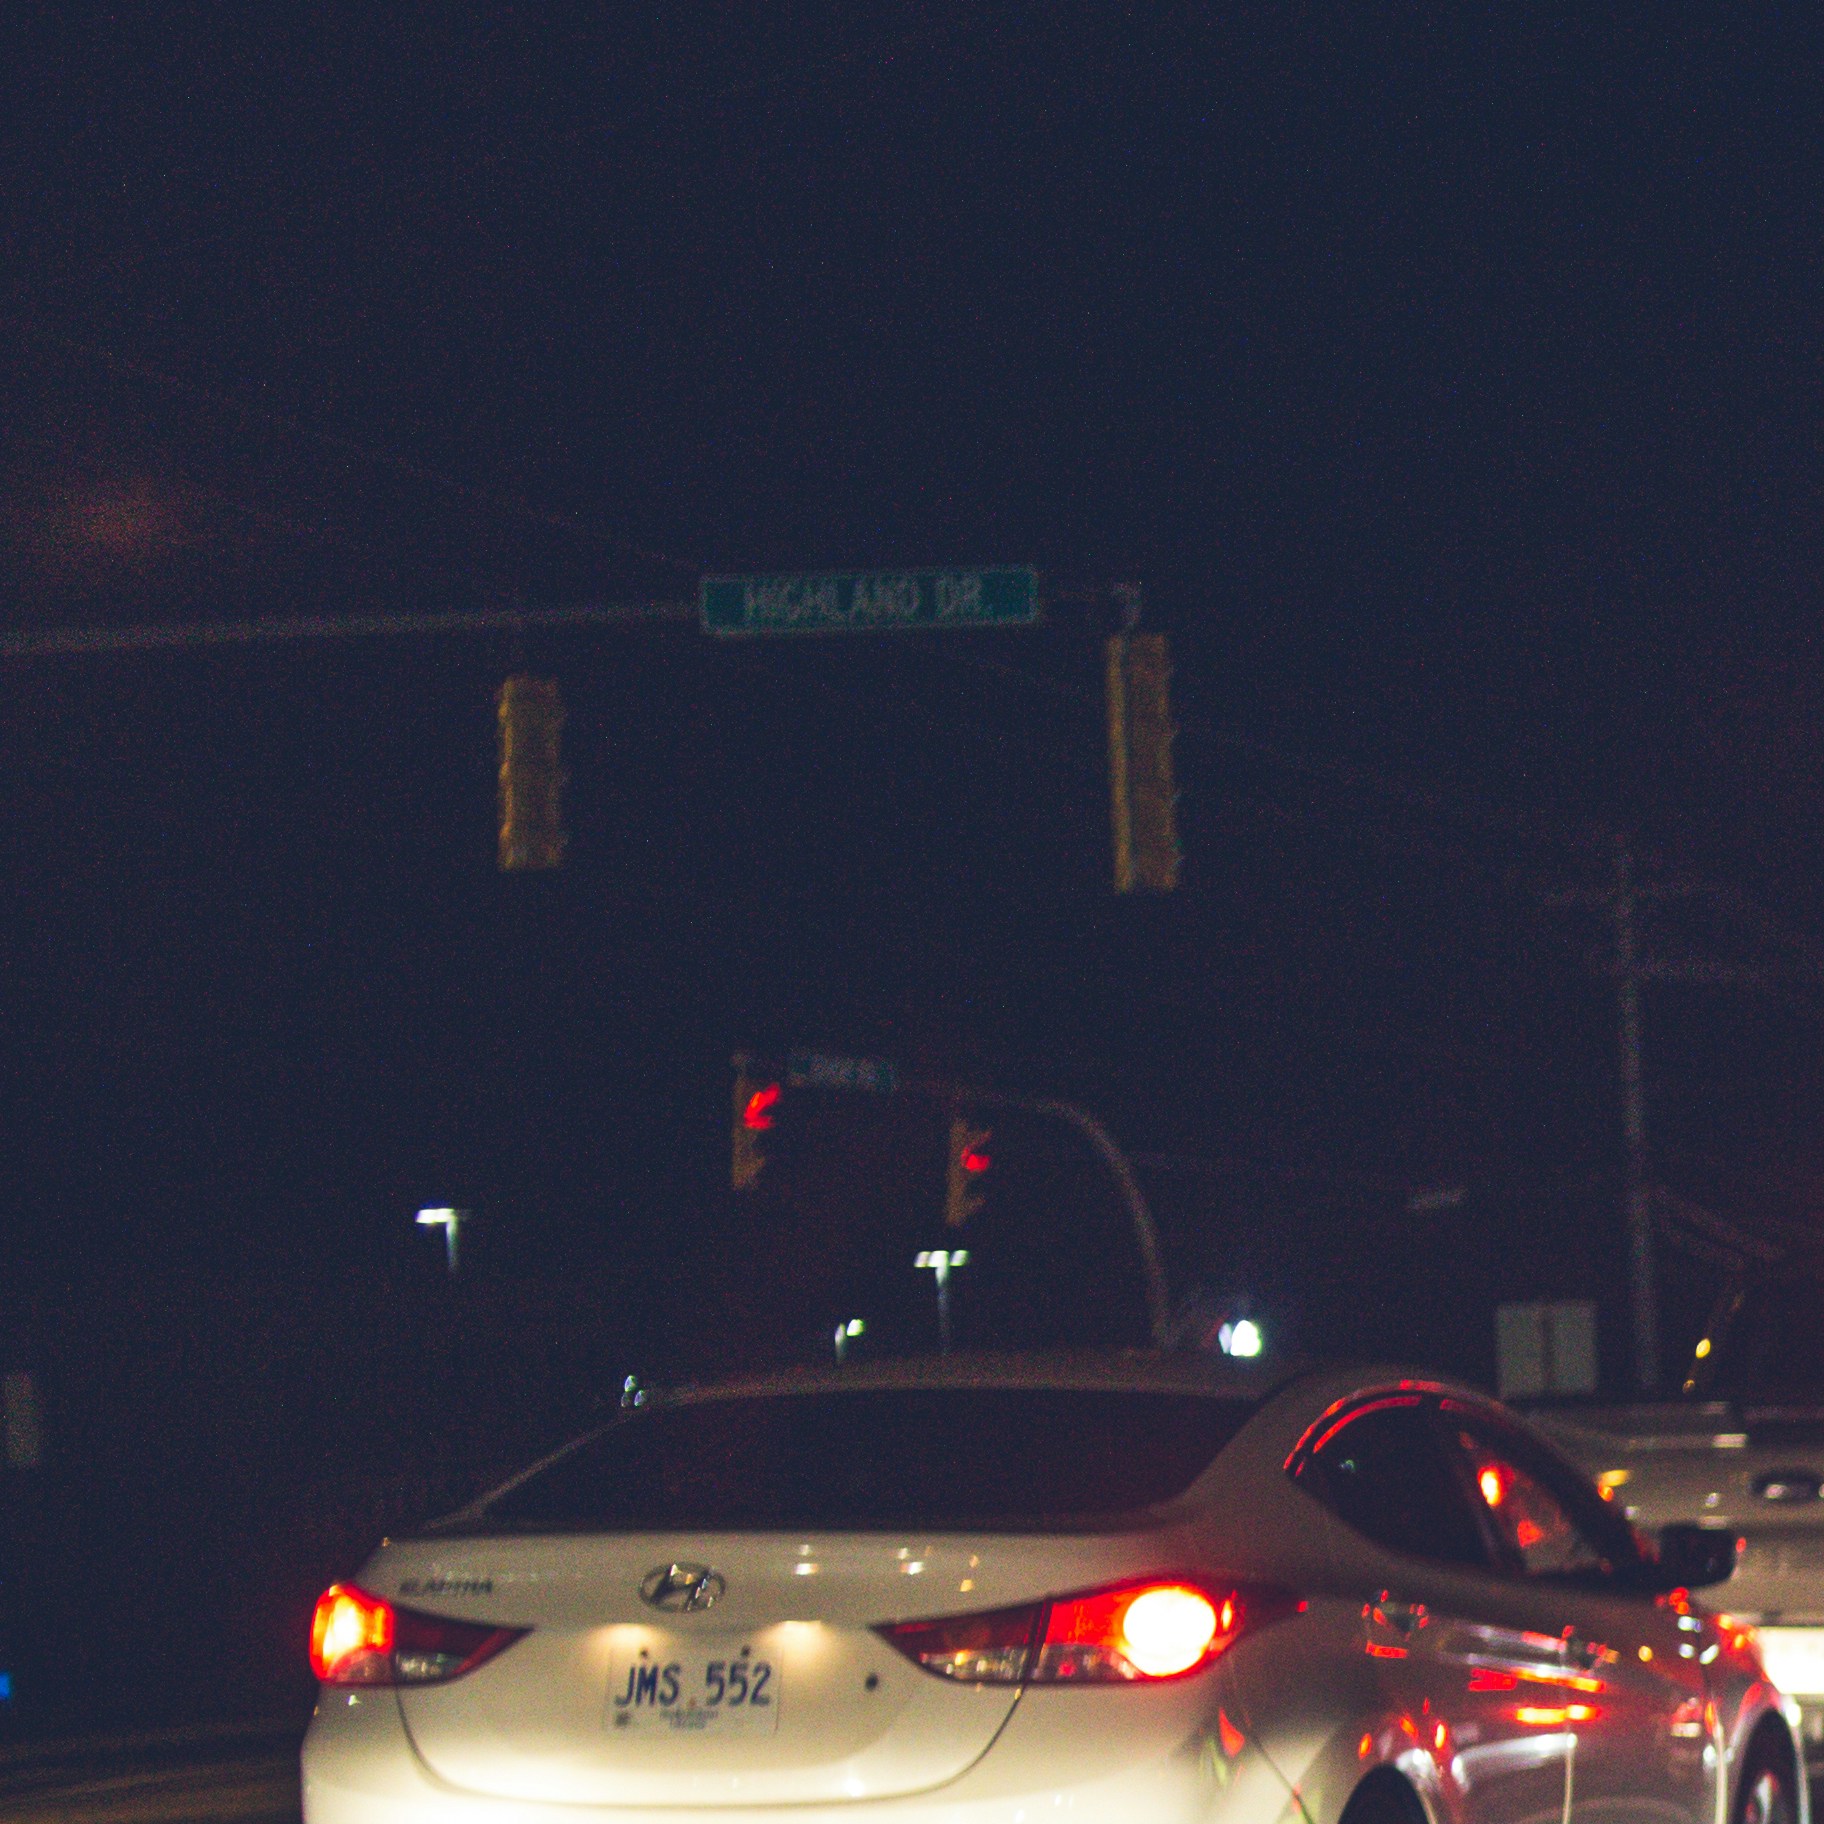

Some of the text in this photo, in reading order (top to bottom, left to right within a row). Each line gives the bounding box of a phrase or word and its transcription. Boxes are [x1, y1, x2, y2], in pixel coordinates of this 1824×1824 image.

[743, 575, 920, 624] HIGHLAND
[615, 1660, 772, 1706] JMS 552
